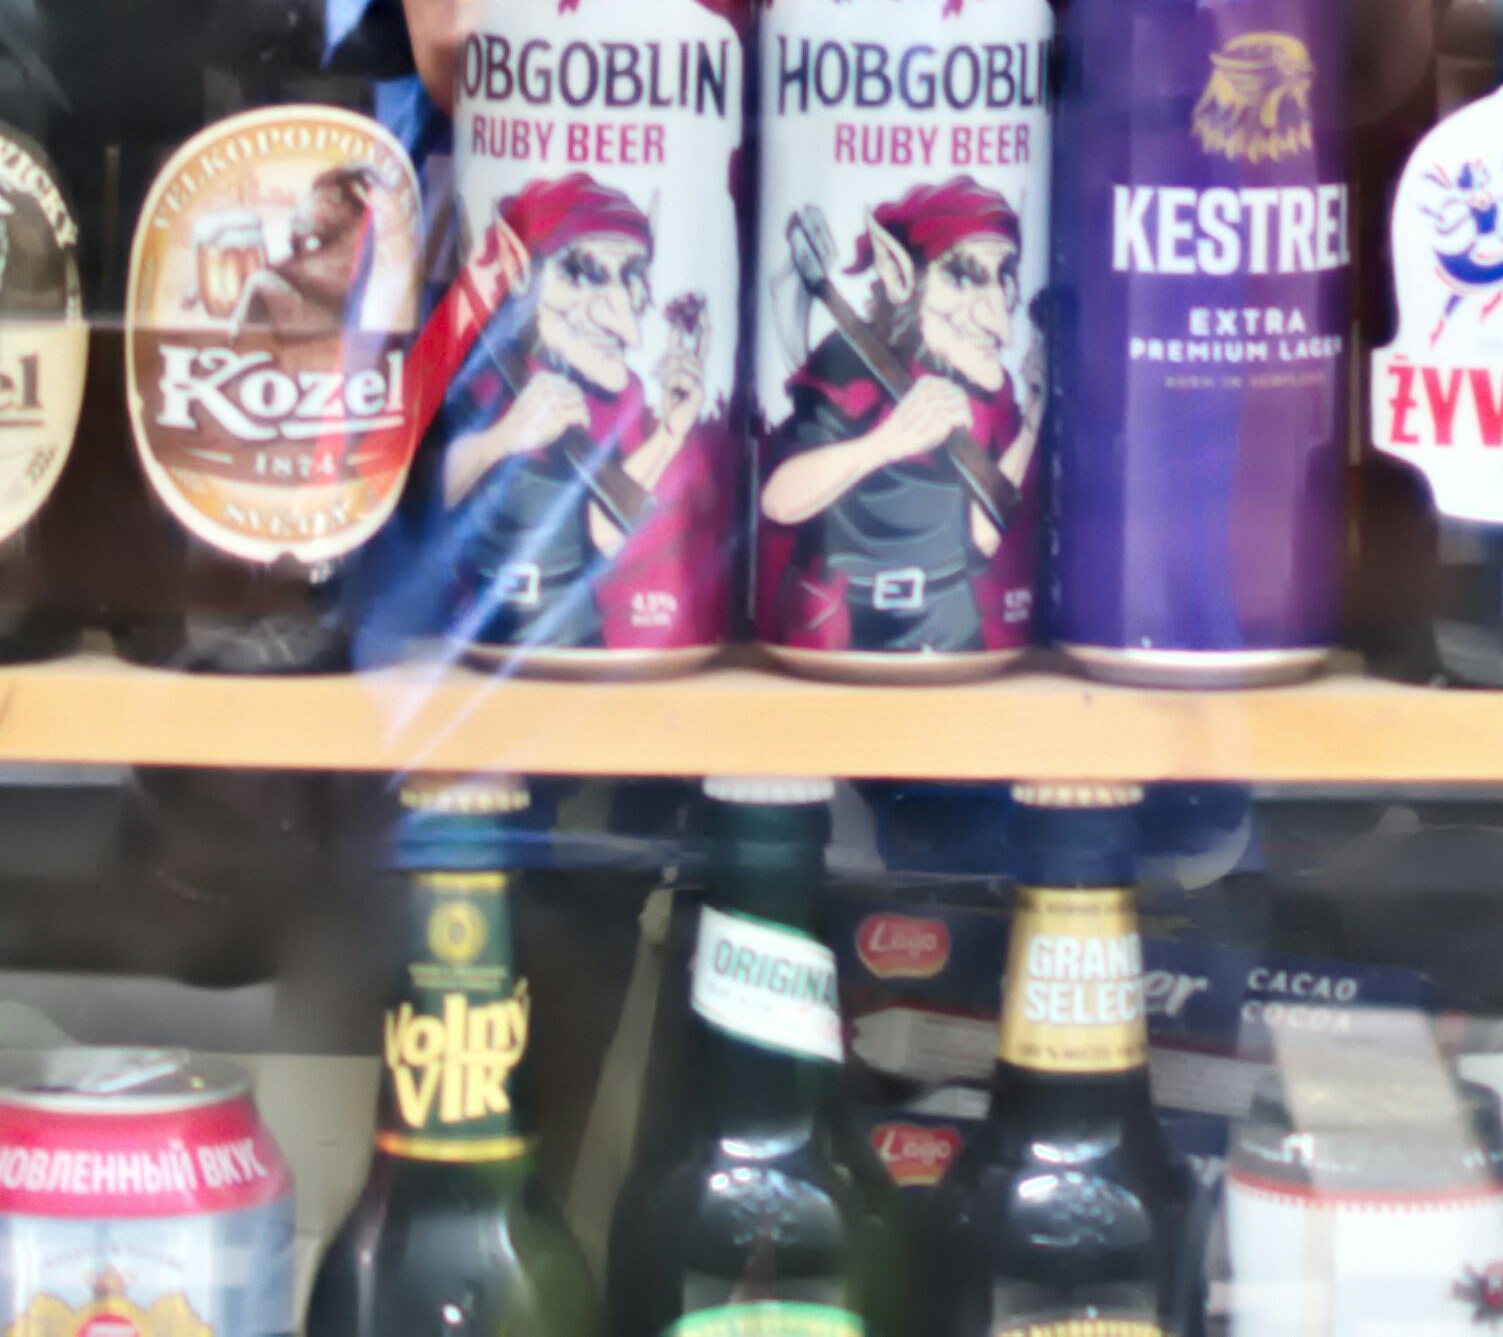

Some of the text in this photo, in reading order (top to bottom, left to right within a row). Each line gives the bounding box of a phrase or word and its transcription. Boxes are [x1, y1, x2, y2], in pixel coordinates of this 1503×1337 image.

[460, 33, 730, 119] OBGOBLIN
[471, 119, 666, 165] RUBY BEER
[834, 121, 1031, 167] RUBY BEER
[1112, 183, 1351, 274] KESTREL
[1188, 308, 1308, 337] EXTRA
[1130, 337, 1268, 363] PREMIUM
[159, 342, 406, 440] Kozel
[253, 451, 336, 479] 1874
[868, 917, 938, 954] Lago
[1246, 967, 1358, 1002] CACAO
[1242, 1001, 1353, 1035] COCOA
[199, 1138, 269, 1188] ВКУС
[879, 1126, 953, 1163] Lago
